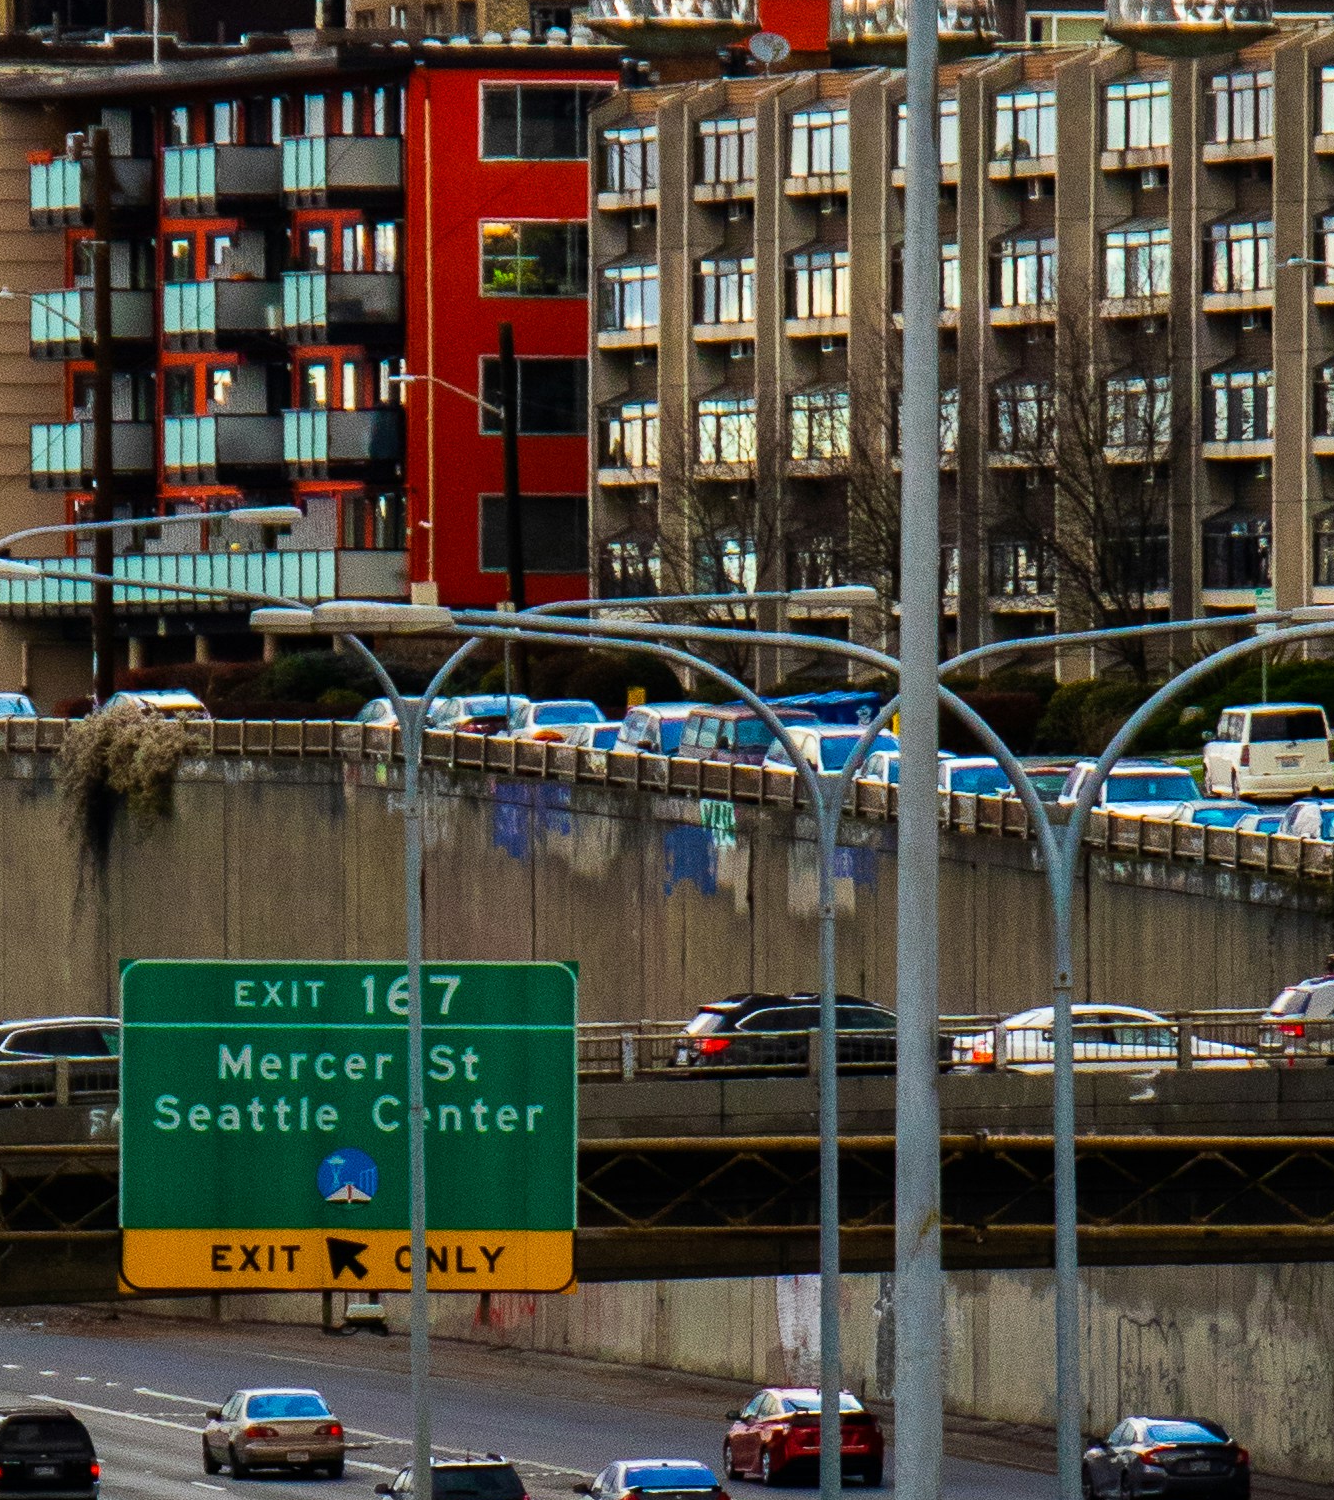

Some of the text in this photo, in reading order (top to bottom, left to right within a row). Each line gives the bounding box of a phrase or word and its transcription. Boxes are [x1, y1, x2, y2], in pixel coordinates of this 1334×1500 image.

[235, 975, 462, 1015] EXIT 167
[218, 1043, 480, 1082] Mercer St
[153, 1094, 340, 1133] Seattle
[210, 1244, 505, 1274] EXIT ONLY
